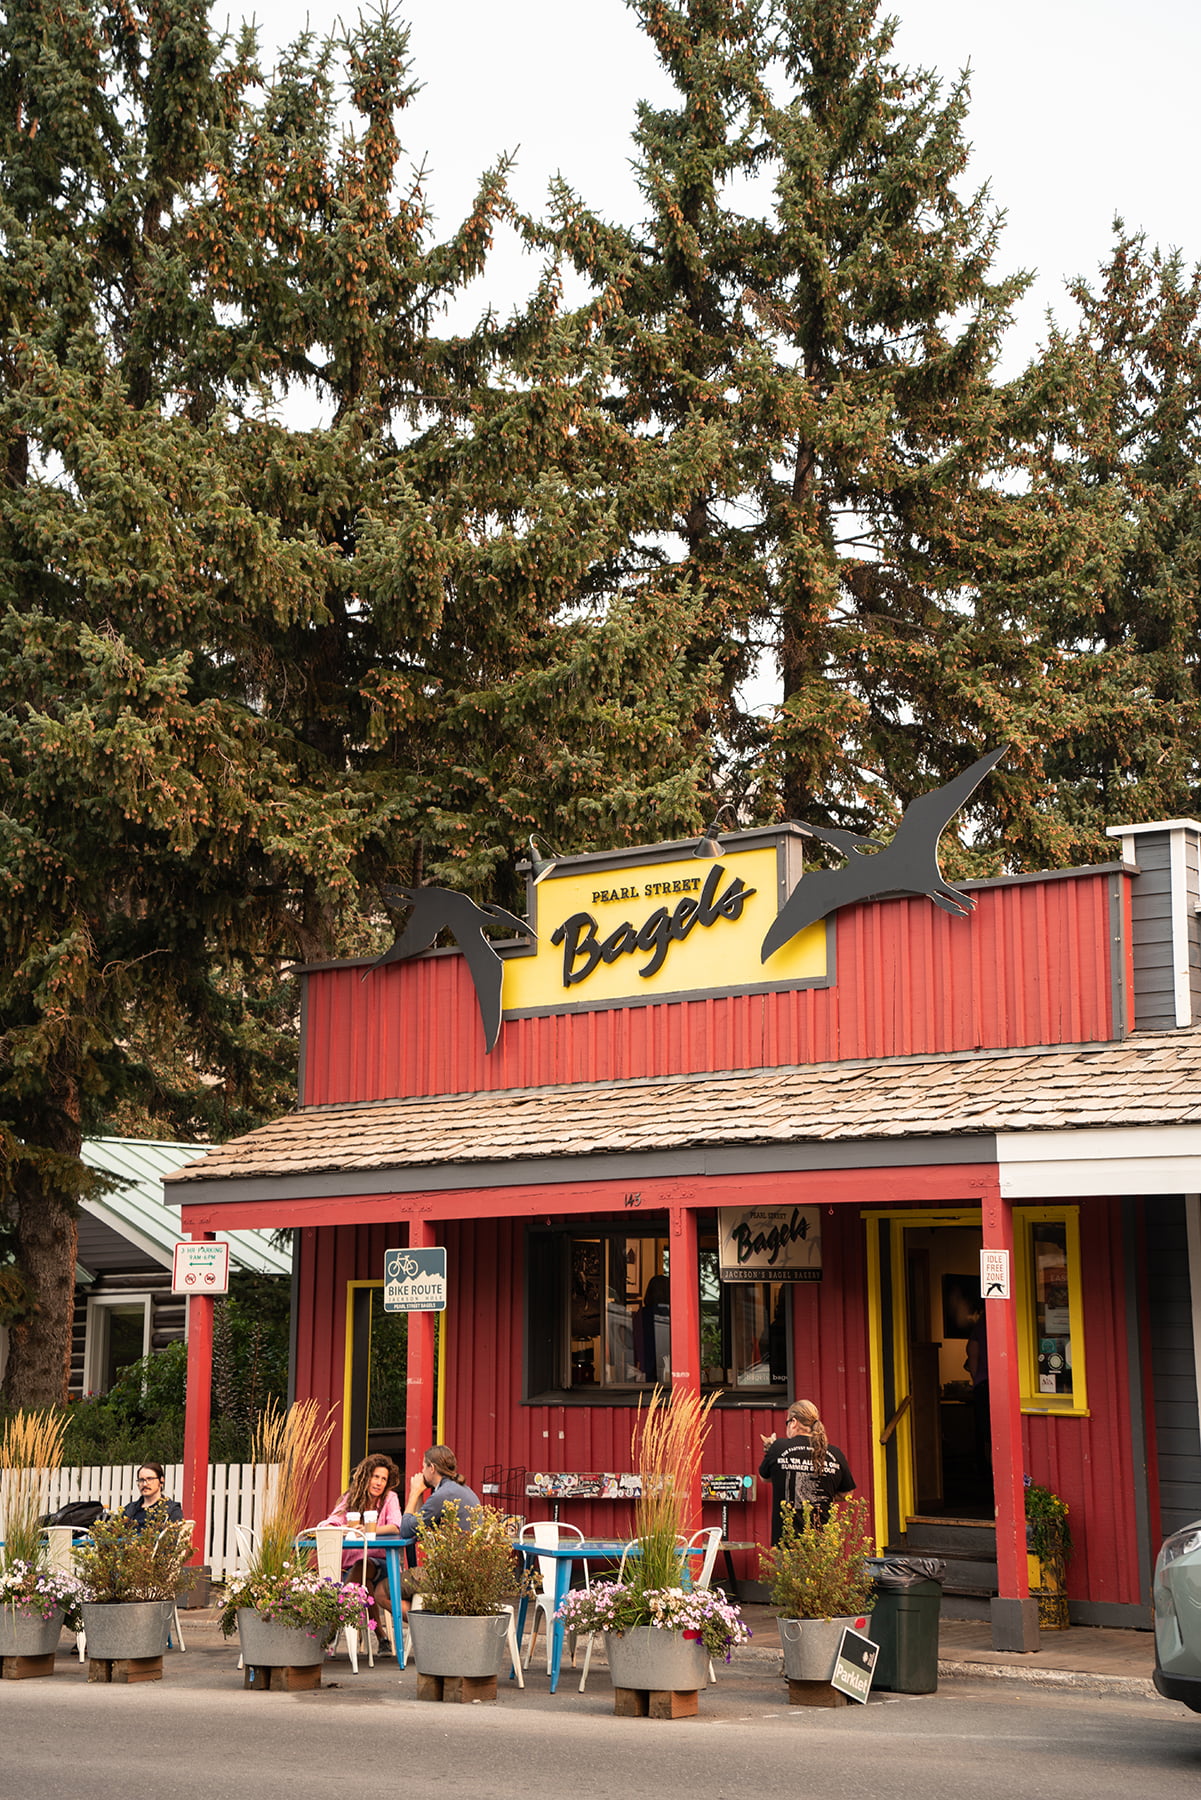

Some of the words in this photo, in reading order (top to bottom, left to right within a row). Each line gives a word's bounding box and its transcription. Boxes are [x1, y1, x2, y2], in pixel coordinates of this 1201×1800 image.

[592, 886, 639, 903] PEARL
[644, 877, 701, 896] STREET
[550, 864, 757, 988] Bagels
[750, 1211, 766, 1219] PEARL
[732, 1207, 810, 1266] Bagels
[987, 1255, 1003, 1263] IDLE
[986, 1264, 1003, 1272] FREE
[725, 1270, 766, 1279] JACKSON'S
[768, 1271, 791, 1279] BAGEL
[794, 1271, 820, 1279] BAKERY
[986, 1273, 1004, 1281] ZONE
[388, 1286, 409, 1296] BIKE
[411, 1284, 442, 1295] ROUTE
[802, 1458, 814, 1466] ALL
[781, 1463, 809, 1471] SUMMER
[835, 1663, 868, 1694] Parklet
